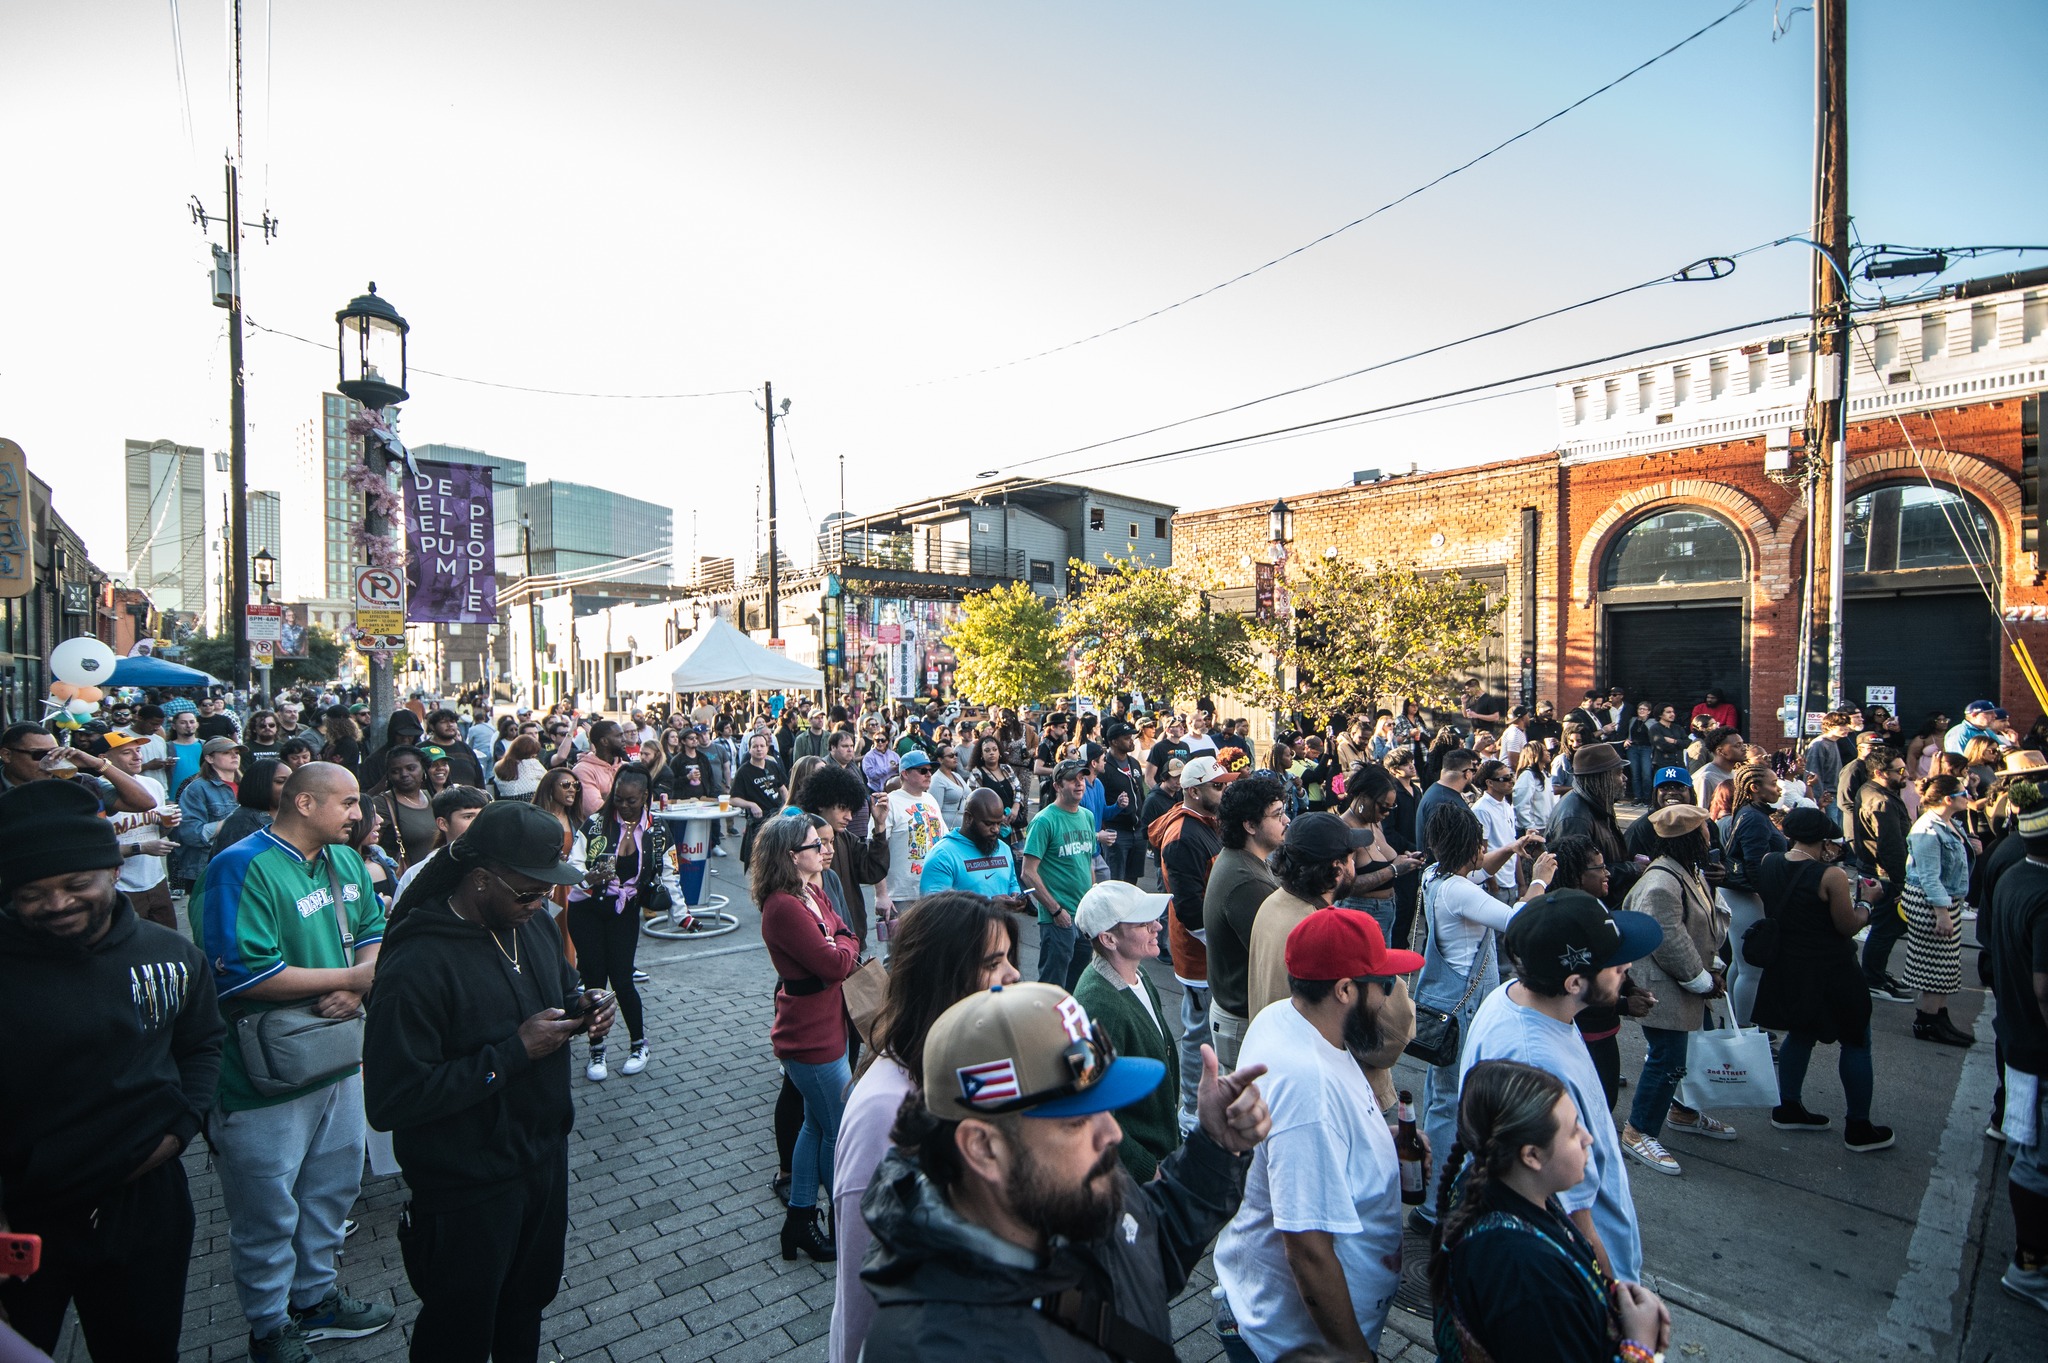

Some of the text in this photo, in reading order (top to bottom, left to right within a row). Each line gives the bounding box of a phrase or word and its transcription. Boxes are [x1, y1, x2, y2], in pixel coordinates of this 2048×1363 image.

[414, 473, 436, 553] DEEP
[436, 478, 457, 576] ELLUM
[466, 504, 486, 612] PEOPLE
[681, 842, 703, 855] Bull
